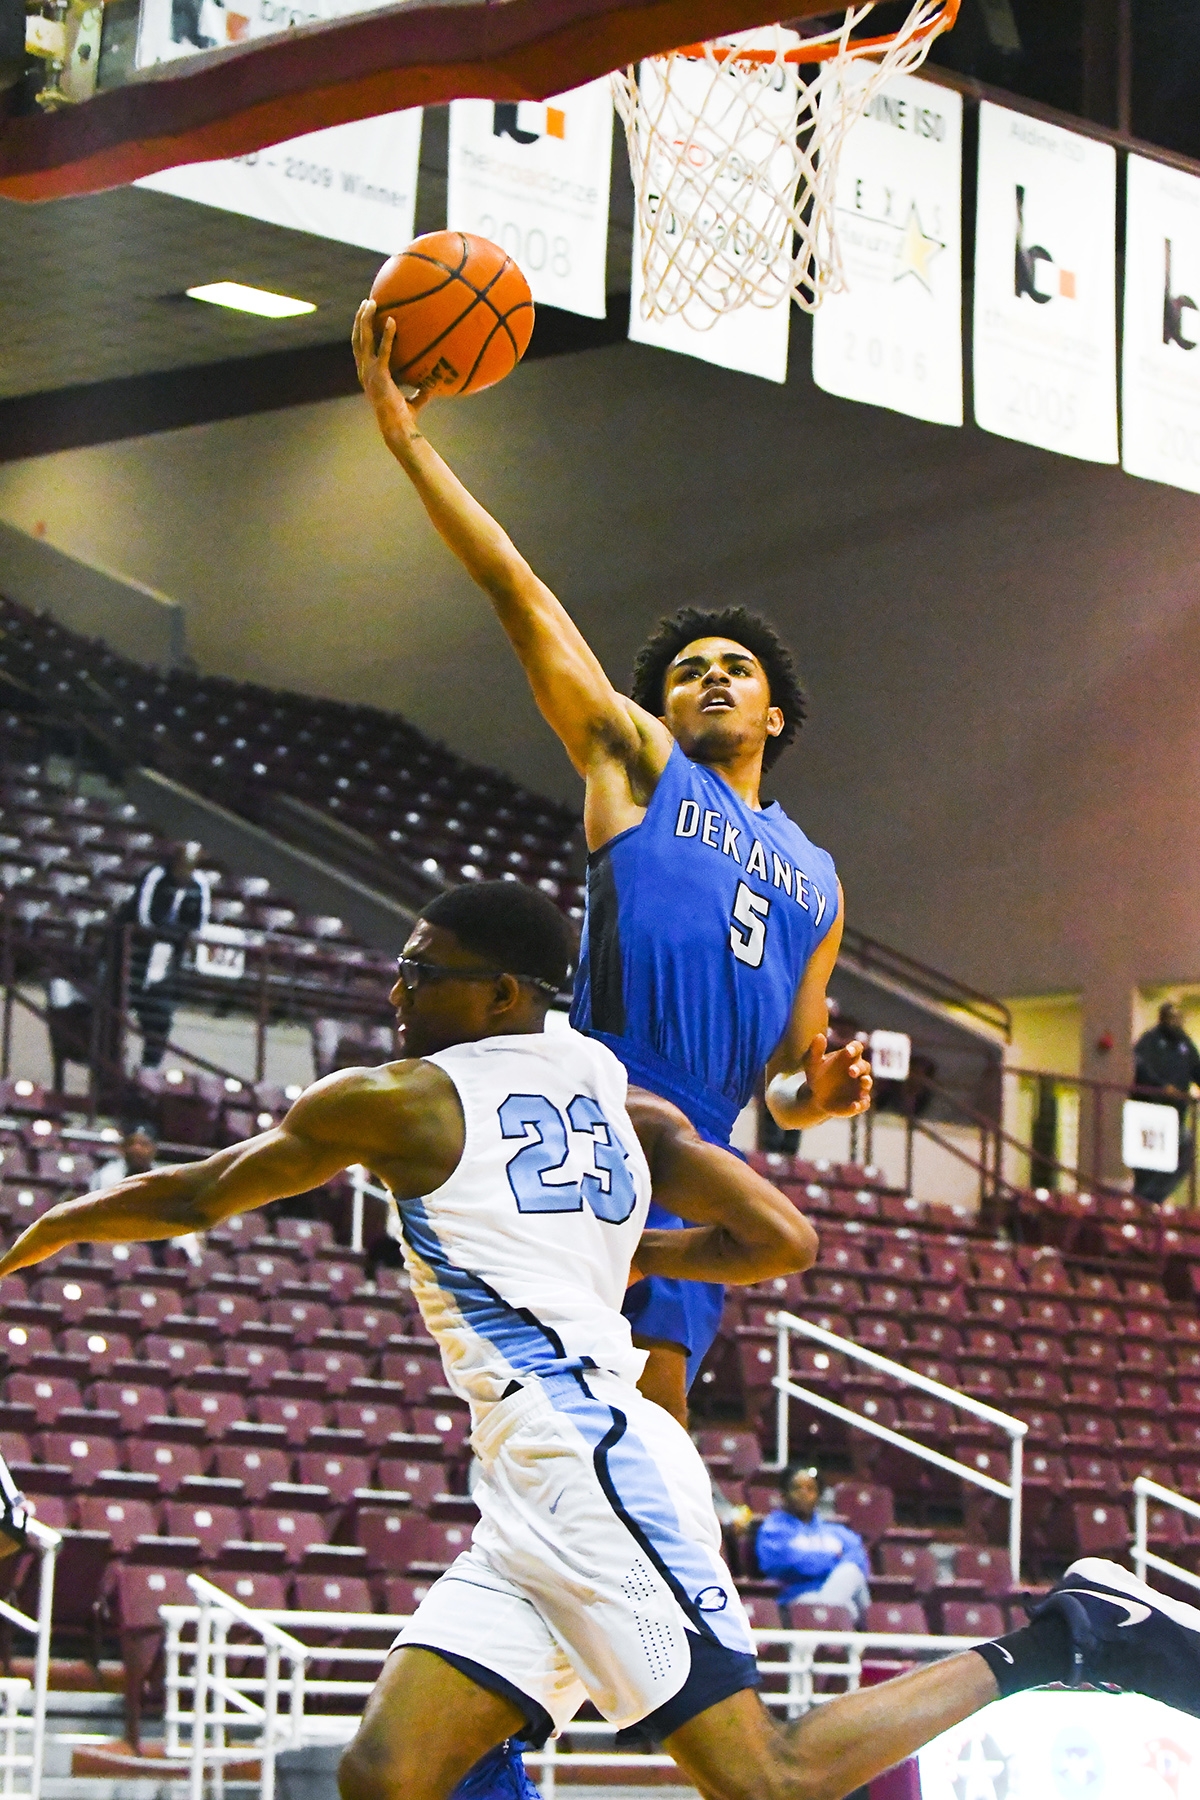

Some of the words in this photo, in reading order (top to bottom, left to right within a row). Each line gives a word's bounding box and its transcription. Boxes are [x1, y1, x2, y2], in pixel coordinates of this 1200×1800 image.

[284, 156, 333, 189] 2009
[340, 170, 408, 209] Winner
[477, 212, 572, 279] 2008
[674, 797, 827, 928] DEKANEY
[728, 878, 771, 970] 5
[496, 1093, 637, 1225] 23
